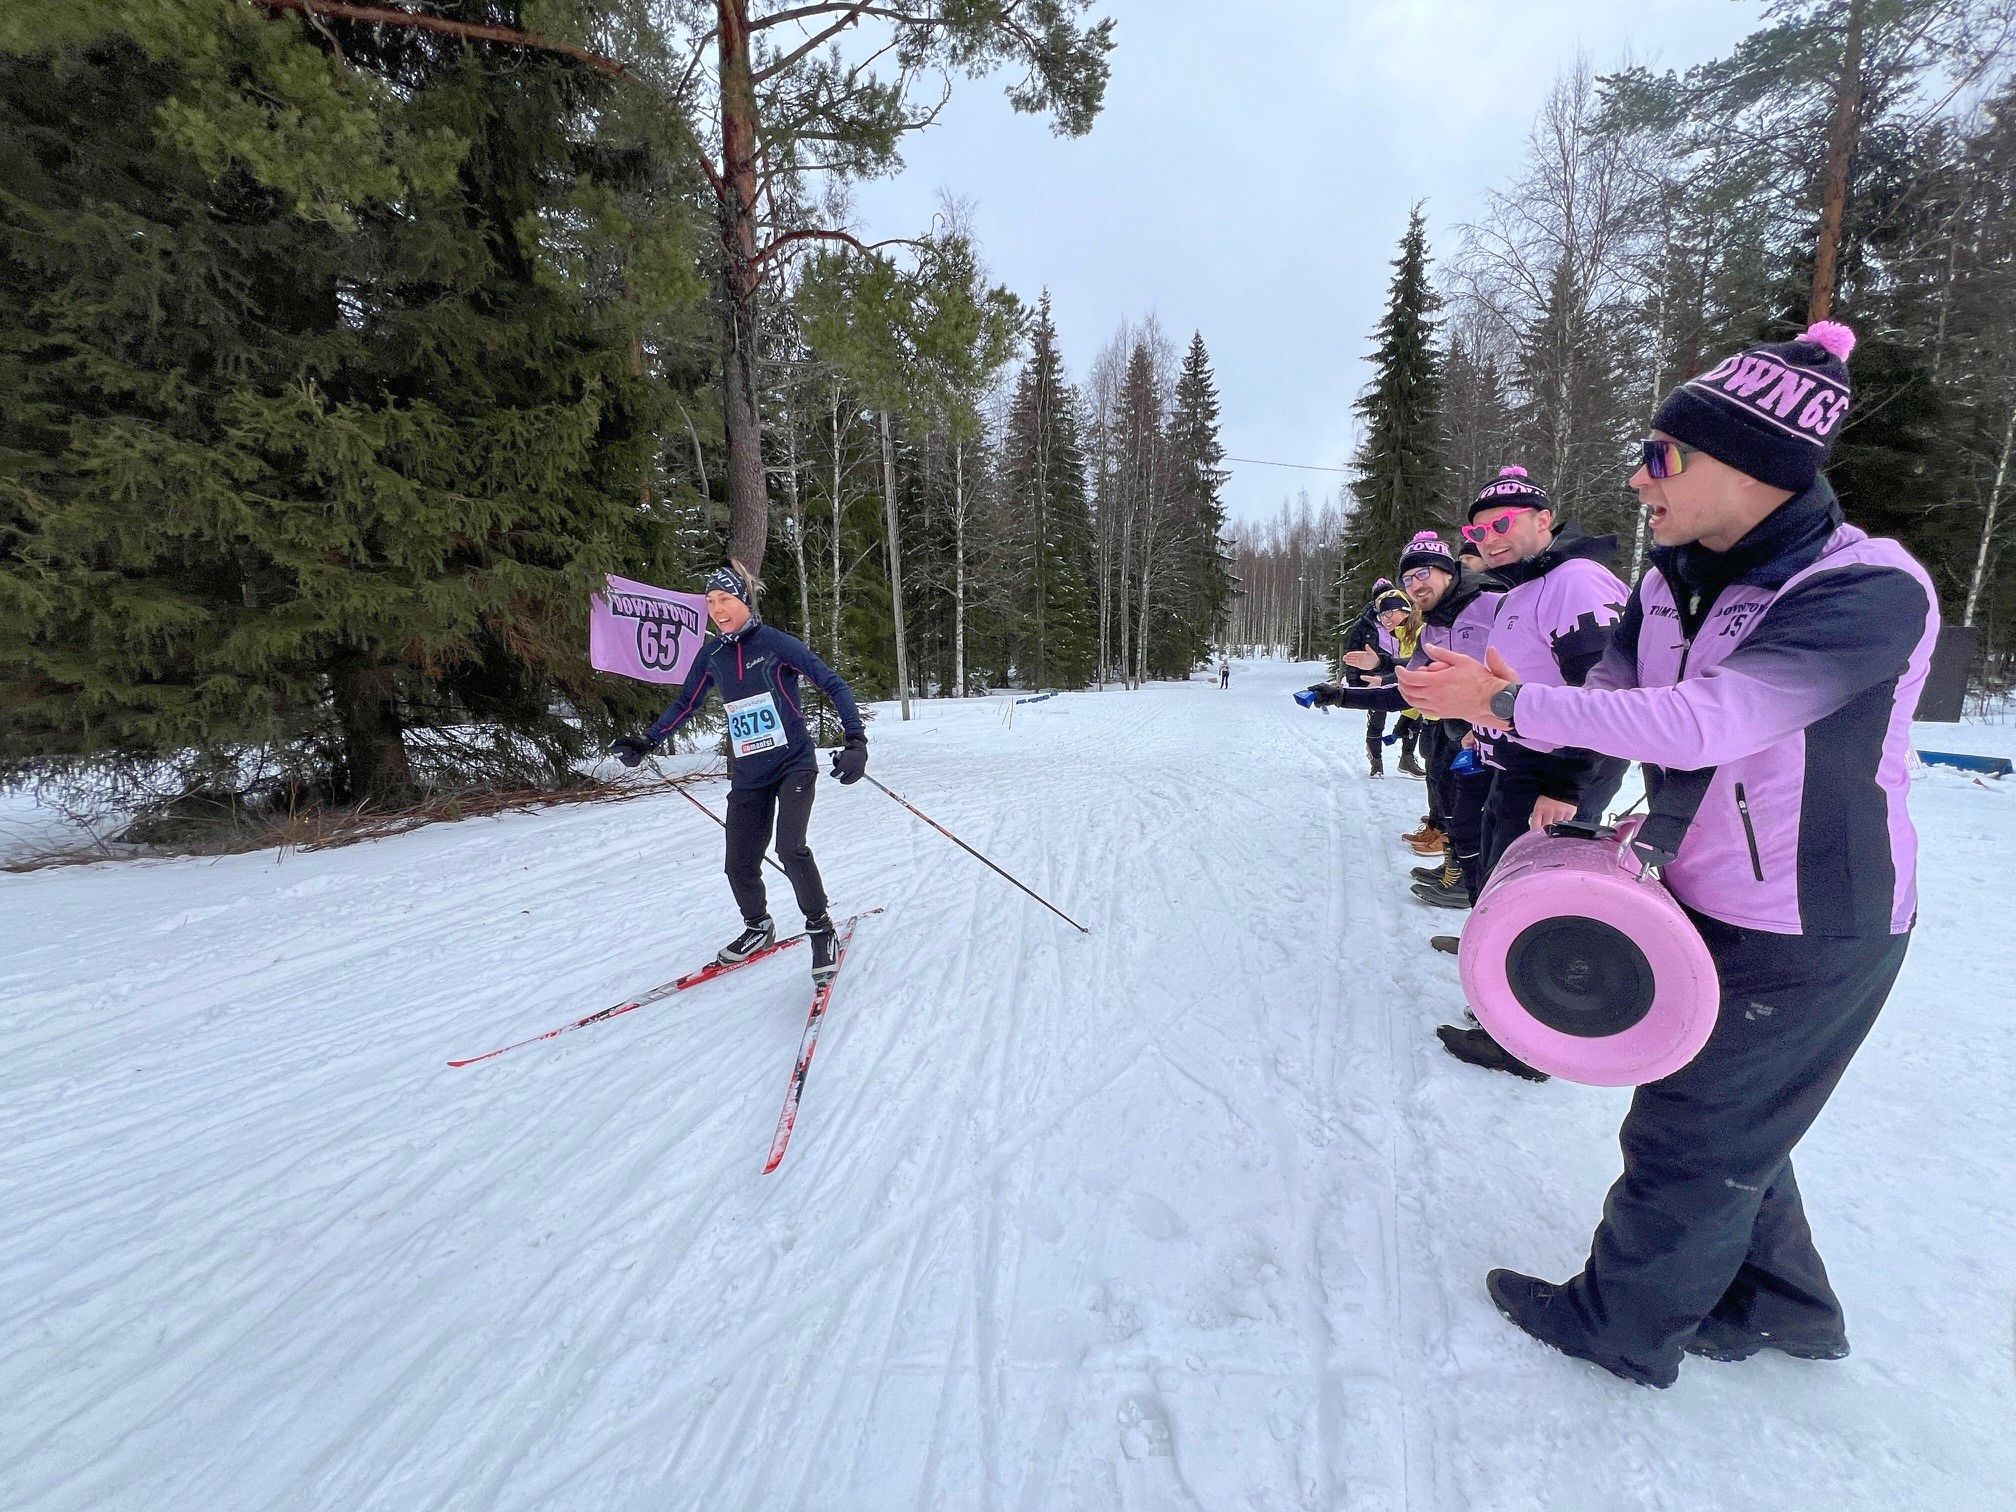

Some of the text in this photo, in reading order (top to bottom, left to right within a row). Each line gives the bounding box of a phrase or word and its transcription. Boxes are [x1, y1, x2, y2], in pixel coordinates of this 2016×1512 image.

[1797, 389, 1849, 436] 65
[611, 594, 697, 631] DOWNTOWN
[640, 621, 676, 666] 65
[732, 709, 777, 738] 3579
